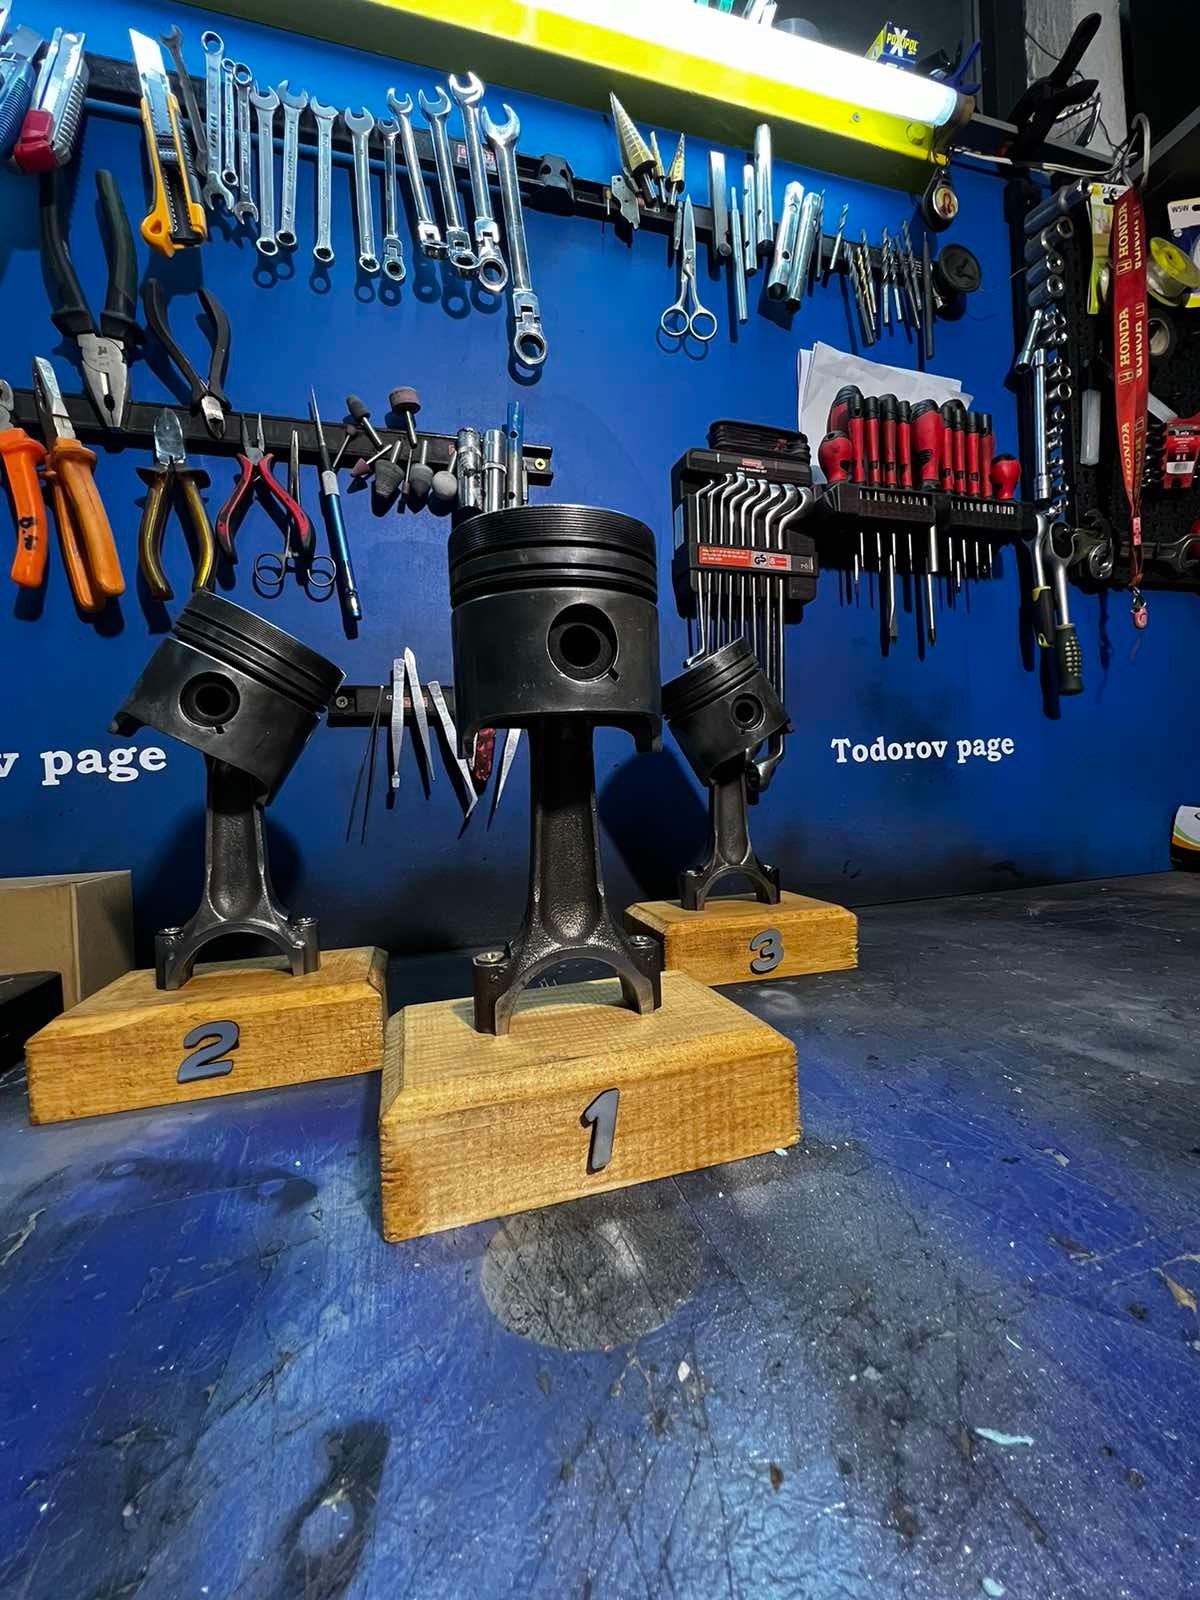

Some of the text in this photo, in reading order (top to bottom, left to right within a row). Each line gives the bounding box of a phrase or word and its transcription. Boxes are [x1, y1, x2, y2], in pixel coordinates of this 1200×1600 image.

[1118, 202, 1129, 259] HONDA
[1119, 307, 1130, 367] HONDA
[40, 746, 167, 786] page
[831, 736, 1015, 764] Todorov page
[750, 928, 784, 975] 3
[177, 1020, 240, 1084] 2
[580, 1087, 620, 1175] 1
